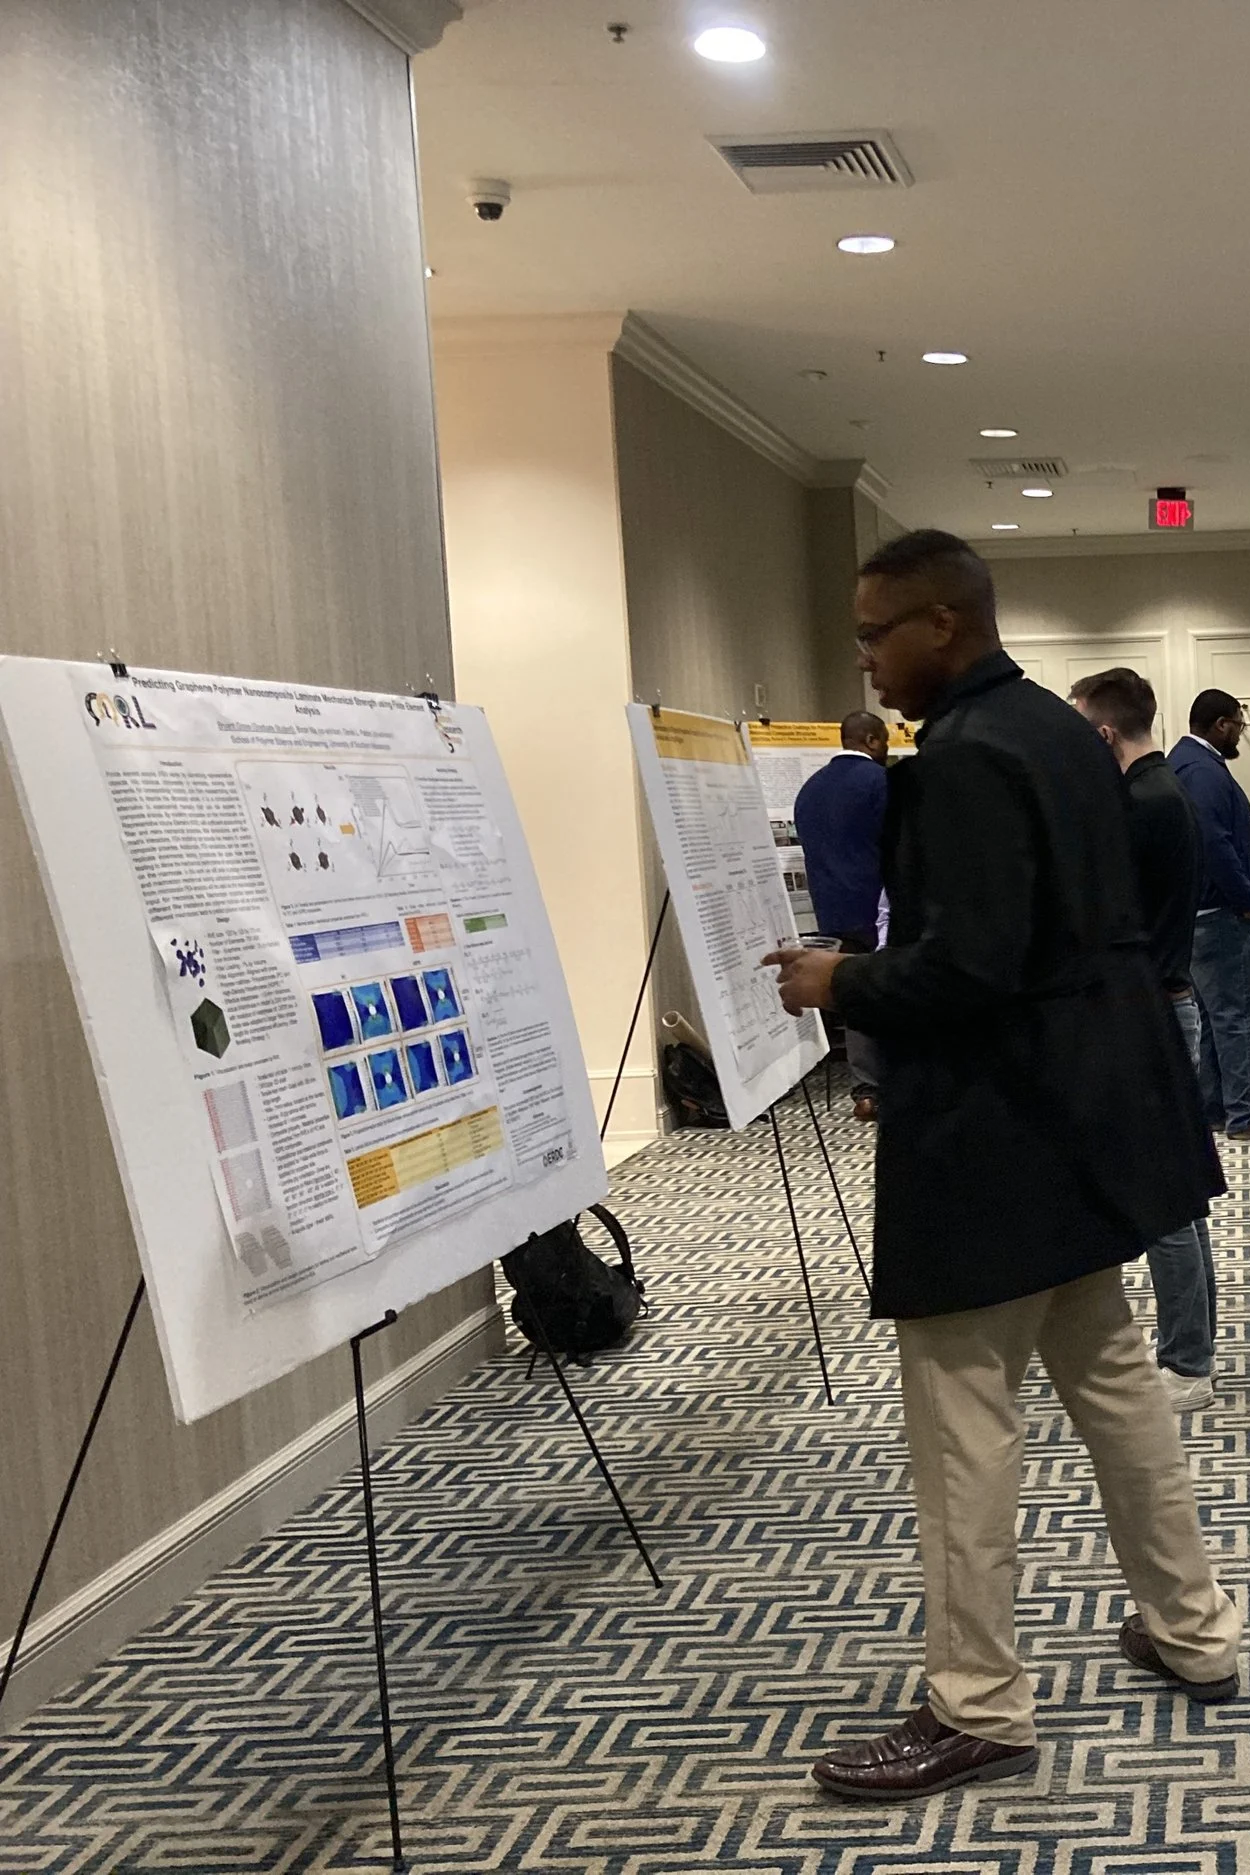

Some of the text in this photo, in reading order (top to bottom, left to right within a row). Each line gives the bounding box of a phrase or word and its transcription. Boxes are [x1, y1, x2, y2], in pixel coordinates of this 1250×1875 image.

[132, 677, 176, 692] Predicting
[175, 680, 213, 694] Graphene
[213, 684, 242, 697] Polymer
[242, 686, 294, 700] Nanocomposite
[321, 694, 354, 706] Mechanical
[294, 704, 321, 717] Analysis
